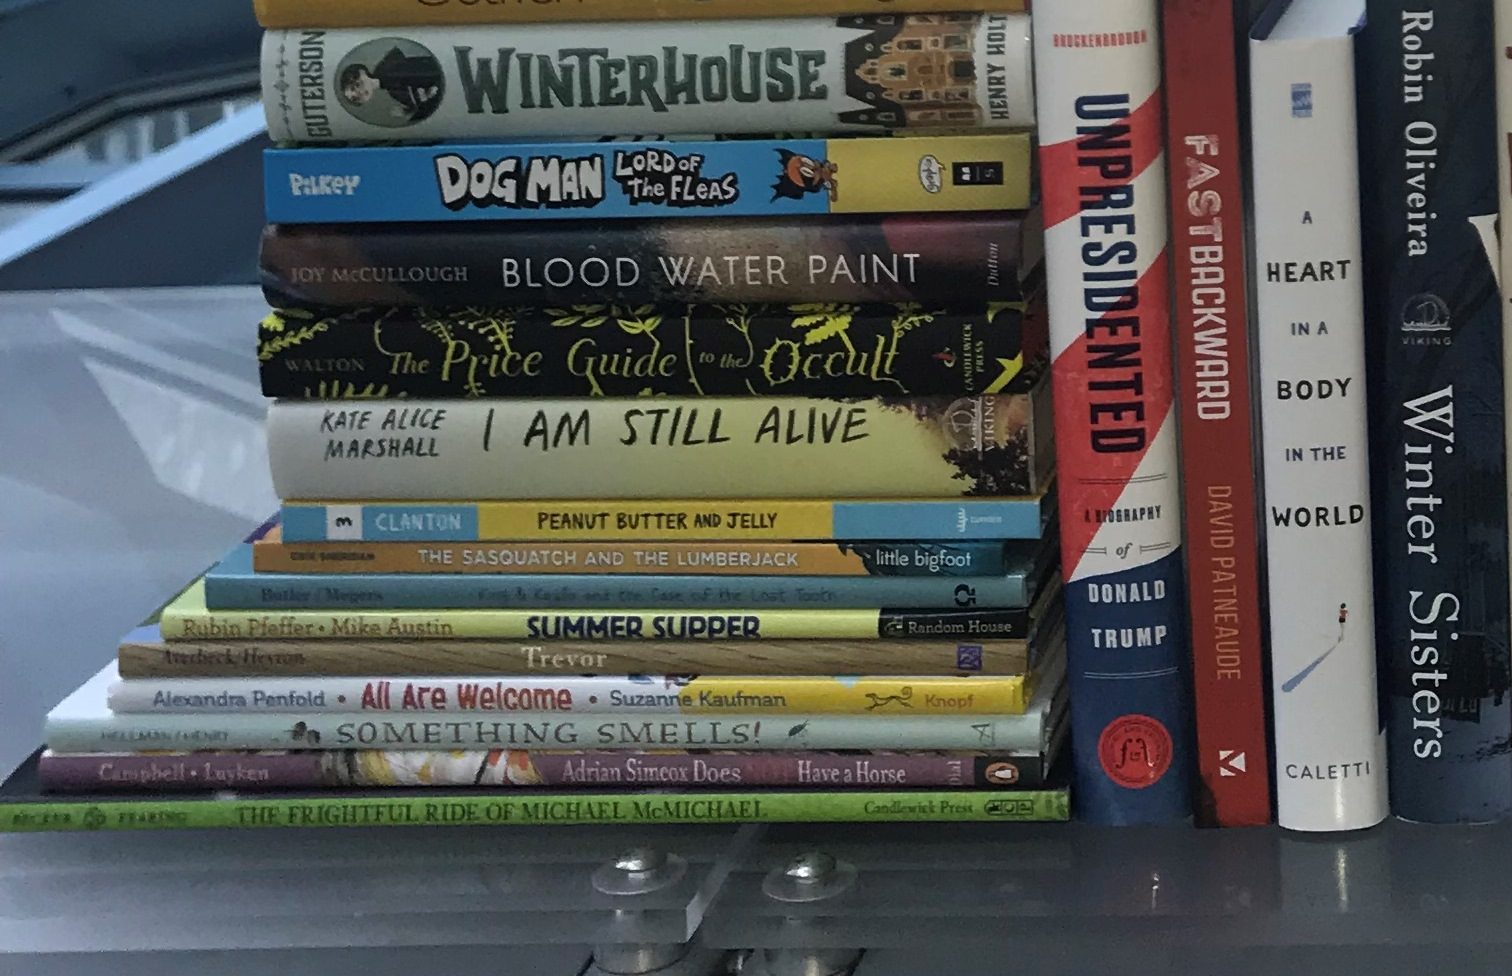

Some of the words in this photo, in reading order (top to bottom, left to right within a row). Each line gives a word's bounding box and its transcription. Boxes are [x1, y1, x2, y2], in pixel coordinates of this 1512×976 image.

[1402, 9, 1436, 104] Robin
[299, 30, 332, 137] GUTERSON
[453, 43, 828, 115] WINTERHOUSE
[435, 154, 518, 205] DOG
[525, 154, 603, 202] MAN
[1402, 121, 1438, 257] Oliveira
[501, 256, 641, 288] BLOOD
[657, 254, 787, 286] WATER
[808, 252, 921, 284] PAINT
[1075, 93, 1147, 454] UNPRESIDENTED
[1266, 259, 1351, 284] HEART
[1290, 321, 1310, 336] IN
[285, 357, 366, 373] WALTON
[441, 337, 544, 382] Price
[566, 336, 677, 378] Guide
[762, 333, 900, 385] Occult
[964, 323, 974, 391] CANDLEWICK
[1276, 377, 1352, 401] BODY
[319, 408, 373, 433] KATE
[380, 407, 447, 432] ALICE
[483, 407, 495, 451] I
[523, 408, 591, 452] AM
[619, 406, 731, 447] STILL
[754, 405, 870, 445] ALIVE
[323, 437, 441, 461] MARSHALL
[1285, 447, 1304, 462] IN
[1310, 445, 1347, 461] THE
[1401, 384, 1455, 564] Winter
[374, 512, 462, 532] CLANTON
[537, 512, 610, 530] PEANUT
[616, 512, 689, 530] BUTTER
[694, 512, 722, 528] AND
[727, 512, 778, 529] JELLY
[1206, 485, 1233, 548] DAVID
[1272, 504, 1365, 528] WORLD
[418, 548, 453, 565] THE
[462, 548, 578, 567] SASQUATCH
[584, 550, 625, 566] AND
[633, 550, 669, 566] THE
[677, 551, 799, 567] LUMBERJACK
[875, 548, 910, 567] little
[914, 549, 973, 573] bigfoot
[1088, 580, 1166, 603] DONALD
[182, 617, 242, 637] Rubin
[331, 618, 381, 637] Mike
[526, 615, 644, 639] SUMMER
[652, 615, 761, 639] SUPPER
[908, 620, 965, 635] Random
[968, 620, 1012, 634] House
[1209, 557, 1241, 681] PATNEAUDE
[1091, 625, 1167, 649] TRUMP
[520, 645, 608, 669] Trevor
[1407, 589, 1461, 760] Sisters
[153, 690, 247, 708] Alexandra
[253, 689, 327, 708] Penfold
[361, 680, 391, 712] All
[402, 682, 448, 711] Are
[457, 680, 572, 712] Welcome
[610, 689, 693, 708] Suzanne
[698, 689, 788, 708] Kaufman
[336, 721, 578, 745] SOMETHING
[596, 720, 762, 745] SMELLS!
[561, 759, 621, 783] Adrian
[856, 760, 907, 784] Horse
[1285, 761, 1370, 781] CALETTI
[288, 802, 420, 824] FRIGHTFUL
[521, 800, 628, 821] MICHAEL
[632, 799, 764, 820] McMICHAEL
[863, 800, 936, 815] Candlewick
[939, 801, 974, 815] Press
